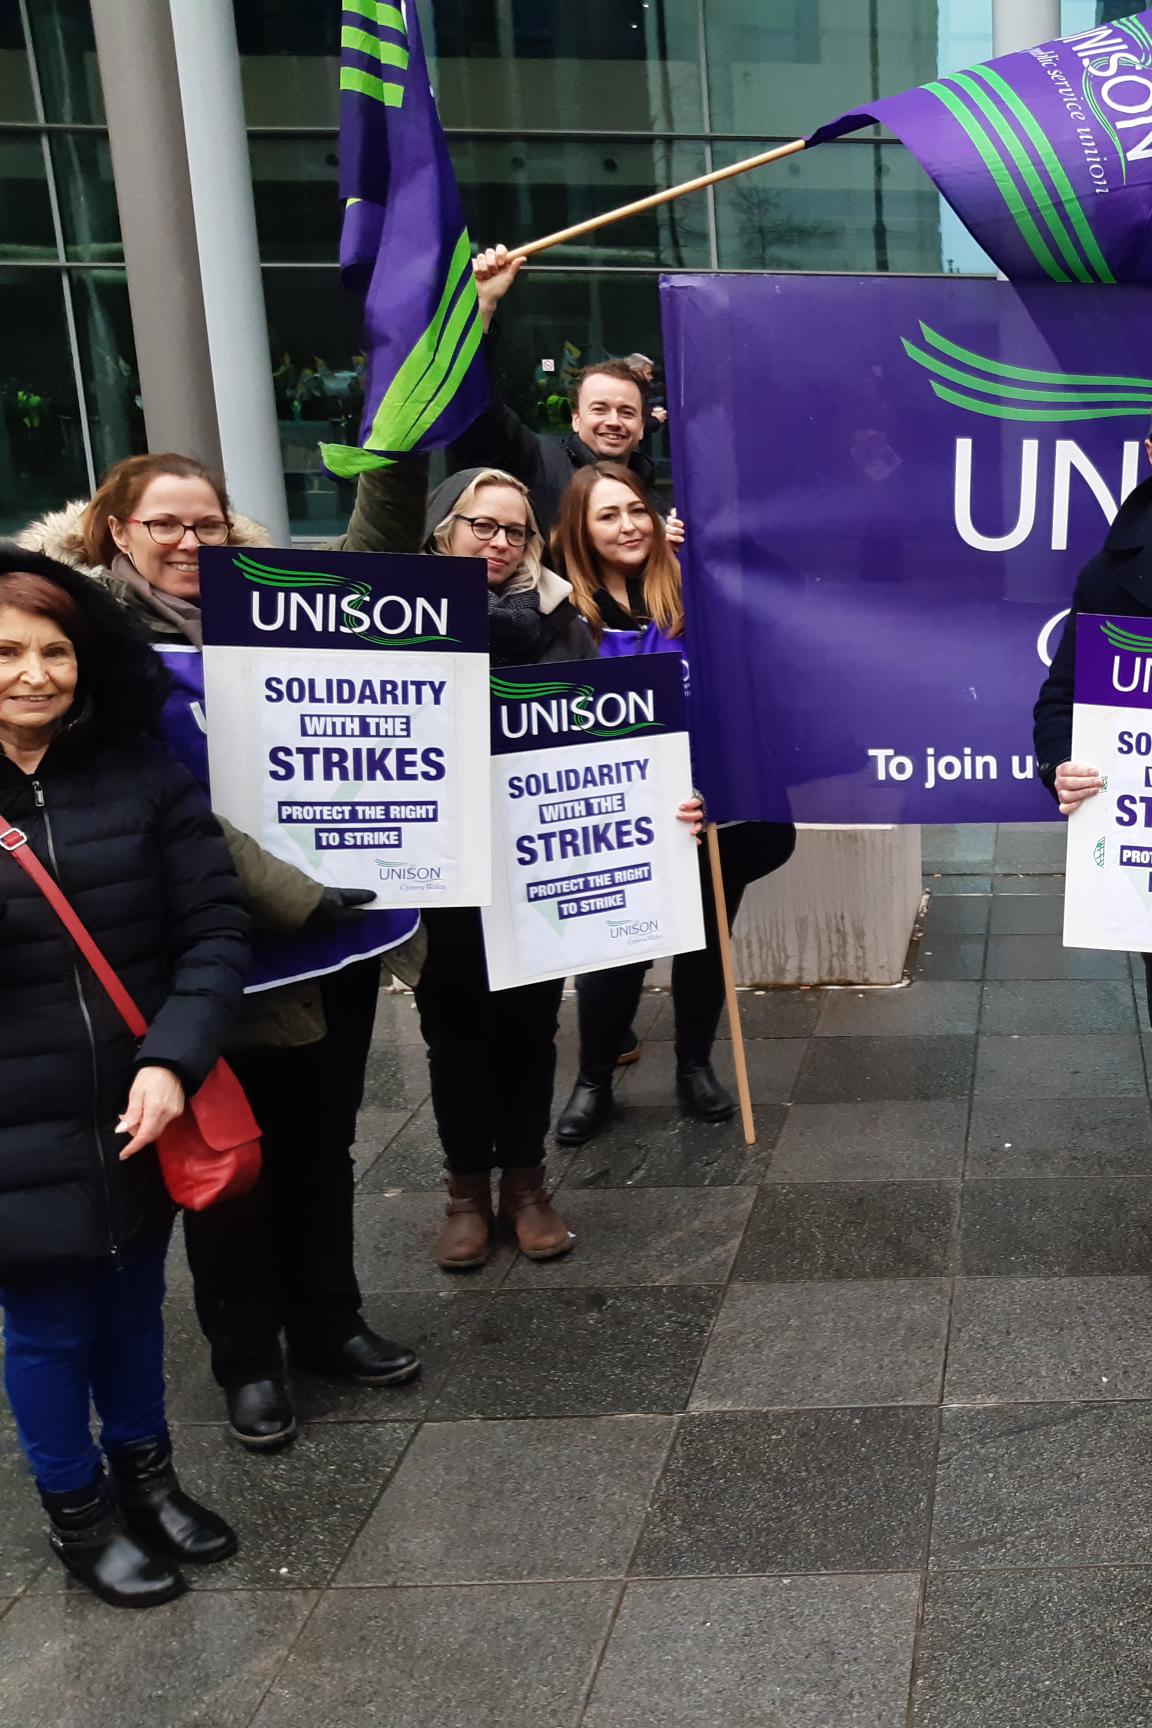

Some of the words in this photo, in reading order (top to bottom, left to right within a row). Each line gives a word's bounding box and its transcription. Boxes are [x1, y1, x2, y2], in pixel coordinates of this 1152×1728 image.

[1047, 69, 1086, 121] service
[1077, 127, 1110, 195] union
[252, 590, 449, 636] UNISON
[265, 676, 447, 705] SOLIDARITY
[304, 716, 360, 736] WITH
[366, 717, 408, 736] THE
[501, 689, 655, 739] UNISON
[268, 746, 446, 781] STRIKES
[508, 758, 650, 799] SOLIDARITY
[868, 749, 914, 781] To
[925, 747, 998, 789] join
[1012, 755, 1039, 780] u
[281, 805, 351, 820] PROTECT
[356, 805, 386, 819] THE
[389, 805, 436, 819] RIGHT
[541, 800, 586, 822] WITH
[590, 795, 623, 814] THE
[318, 832, 340, 846] TO
[344, 831, 399, 846] STRIKE
[516, 816, 655, 866] STRIKES
[379, 866, 441, 880] UNISON
[529, 877, 585, 899] PROTECT
[588, 873, 612, 888] THE
[614, 866, 650, 881] RIGHT
[560, 902, 578, 916] TO
[580, 894, 624, 912] STRIKE
[610, 919, 659, 939] UNISON
